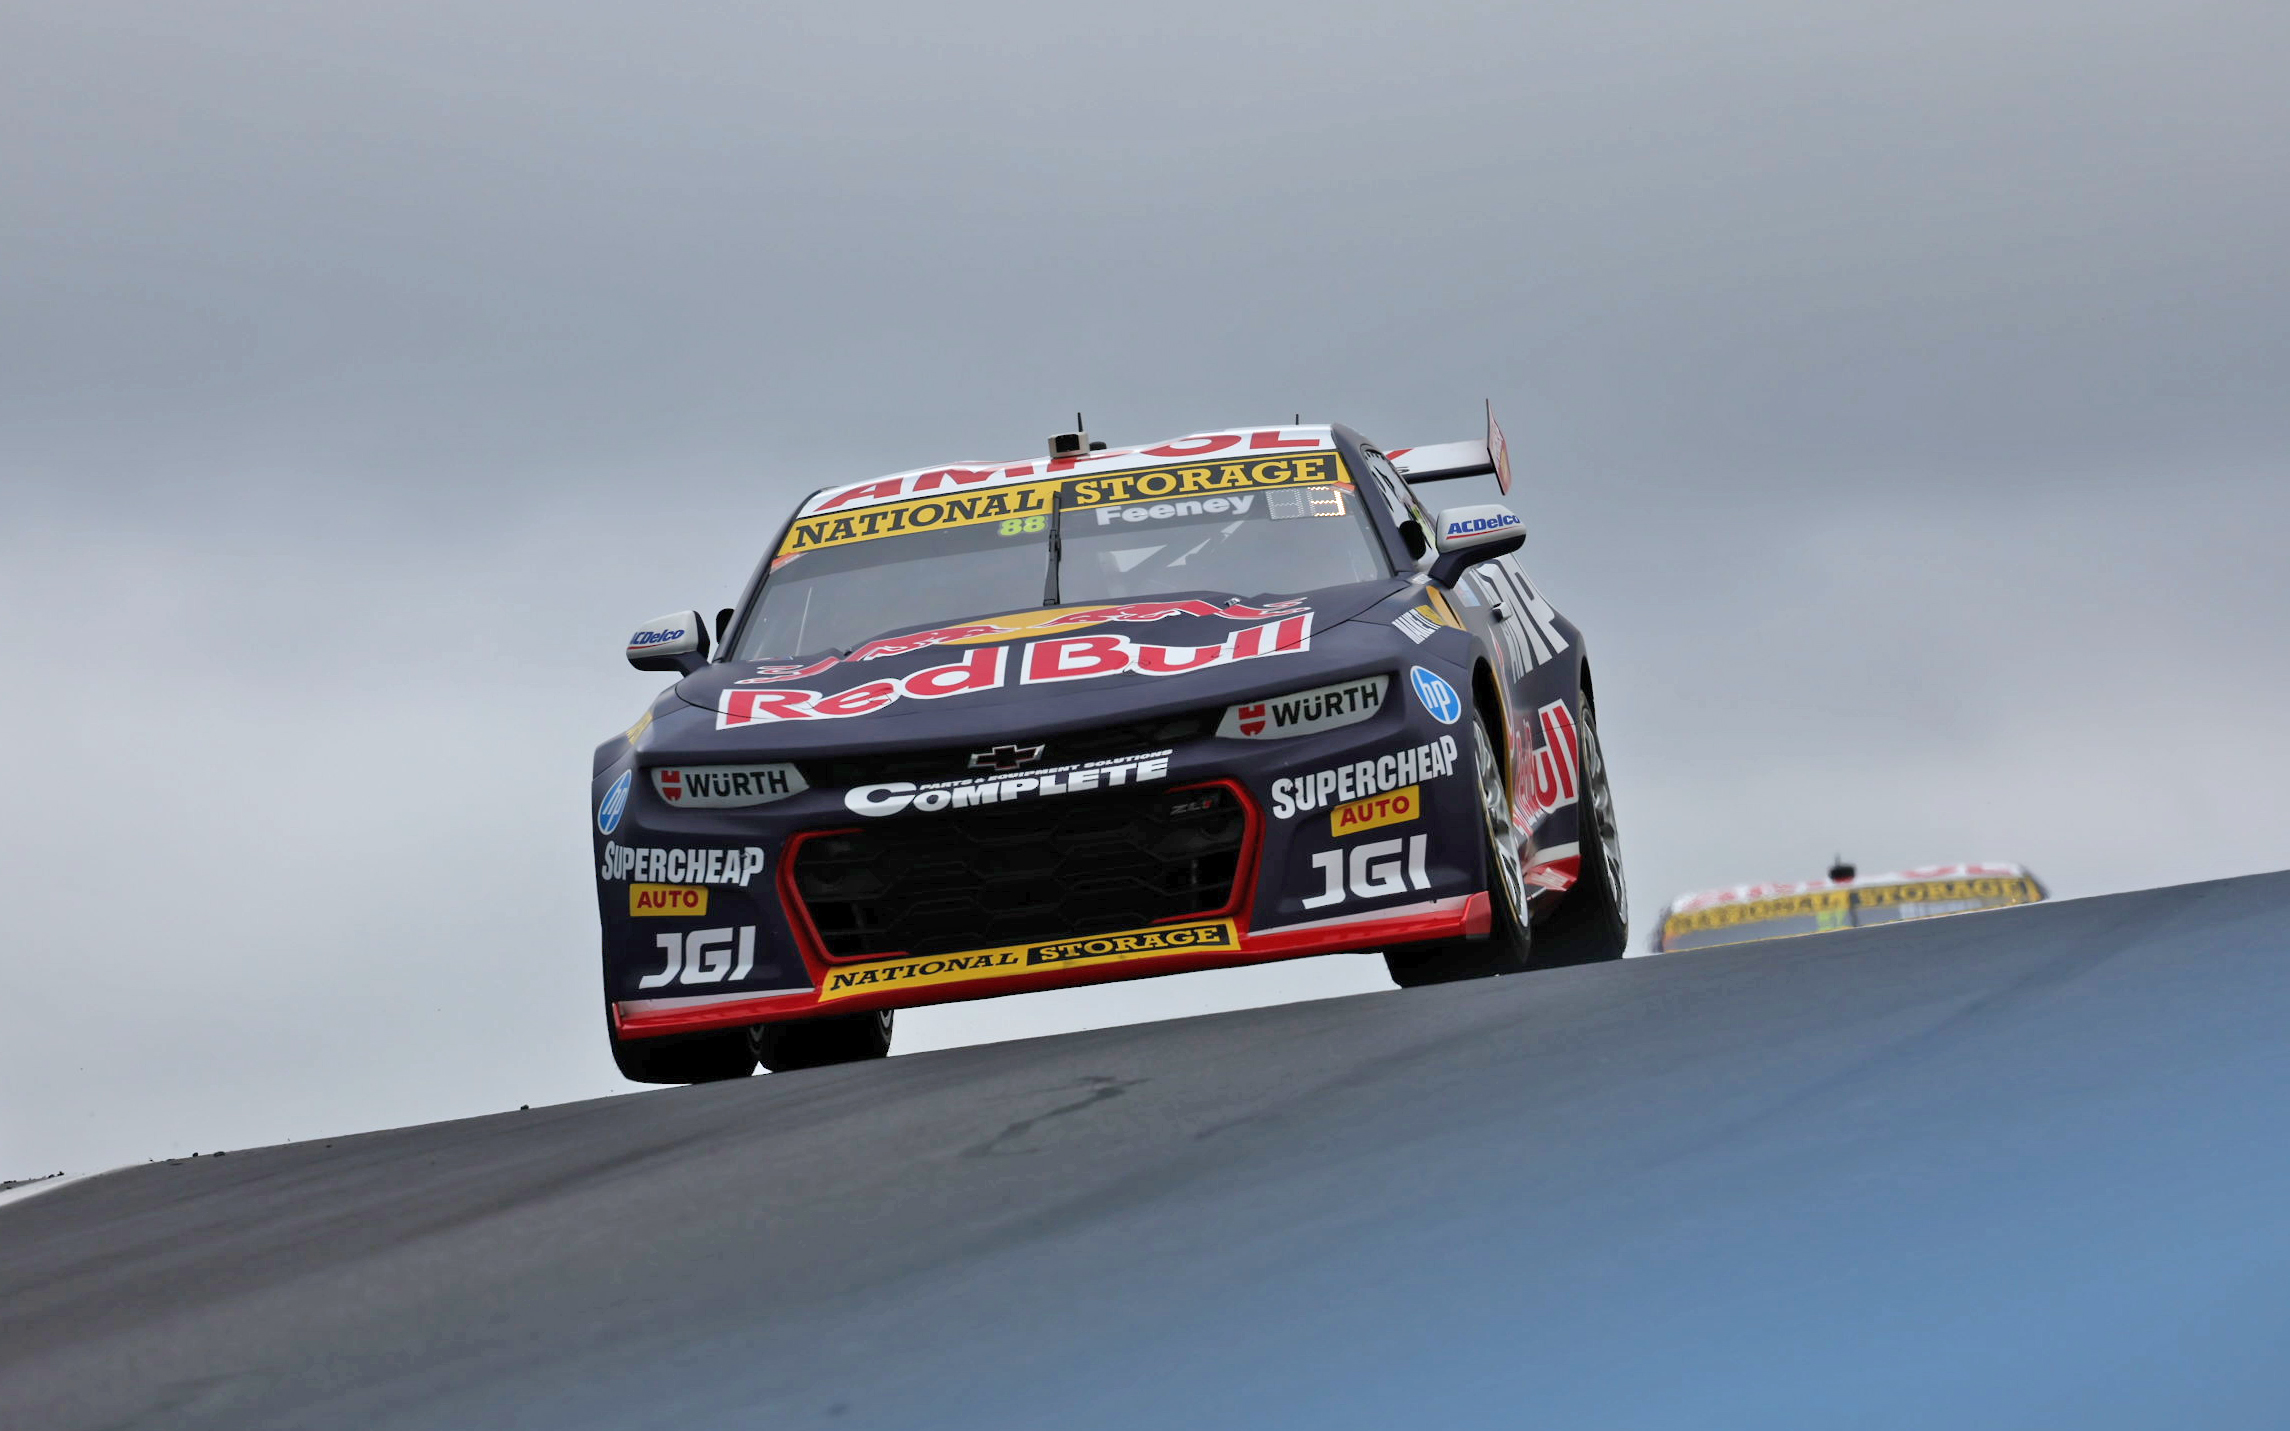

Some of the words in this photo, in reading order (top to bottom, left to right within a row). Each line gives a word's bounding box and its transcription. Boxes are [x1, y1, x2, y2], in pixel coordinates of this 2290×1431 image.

[813, 430, 1320, 512] AMPOL
[792, 489, 1044, 549] NATIONAL
[1076, 458, 1325, 505] STORAGE
[1000, 515, 1046, 536] 88
[1096, 494, 1255, 526] Feeney
[1447, 514, 1521, 534] ACDelco
[715, 646, 1010, 731] Red
[1020, 612, 1315, 685] Bull
[1413, 668, 1451, 722] hp
[844, 757, 1169, 817] COMPLETE
[919, 778, 973, 791] PARTS
[987, 764, 1081, 782] EQUIPMENT
[1083, 749, 1173, 769] SOLUTIONS
[1271, 735, 1458, 820] SUPERCHEAP
[602, 773, 628, 832] hp
[1340, 795, 1410, 827] AUTO
[602, 840, 765, 887] SUPERCHEAP
[1302, 833, 1431, 910] JGI
[636, 890, 699, 909] AUTO
[638, 925, 756, 990] JGI
[830, 952, 1019, 991] NATIONAL
[1039, 927, 1220, 963] STORAGE
